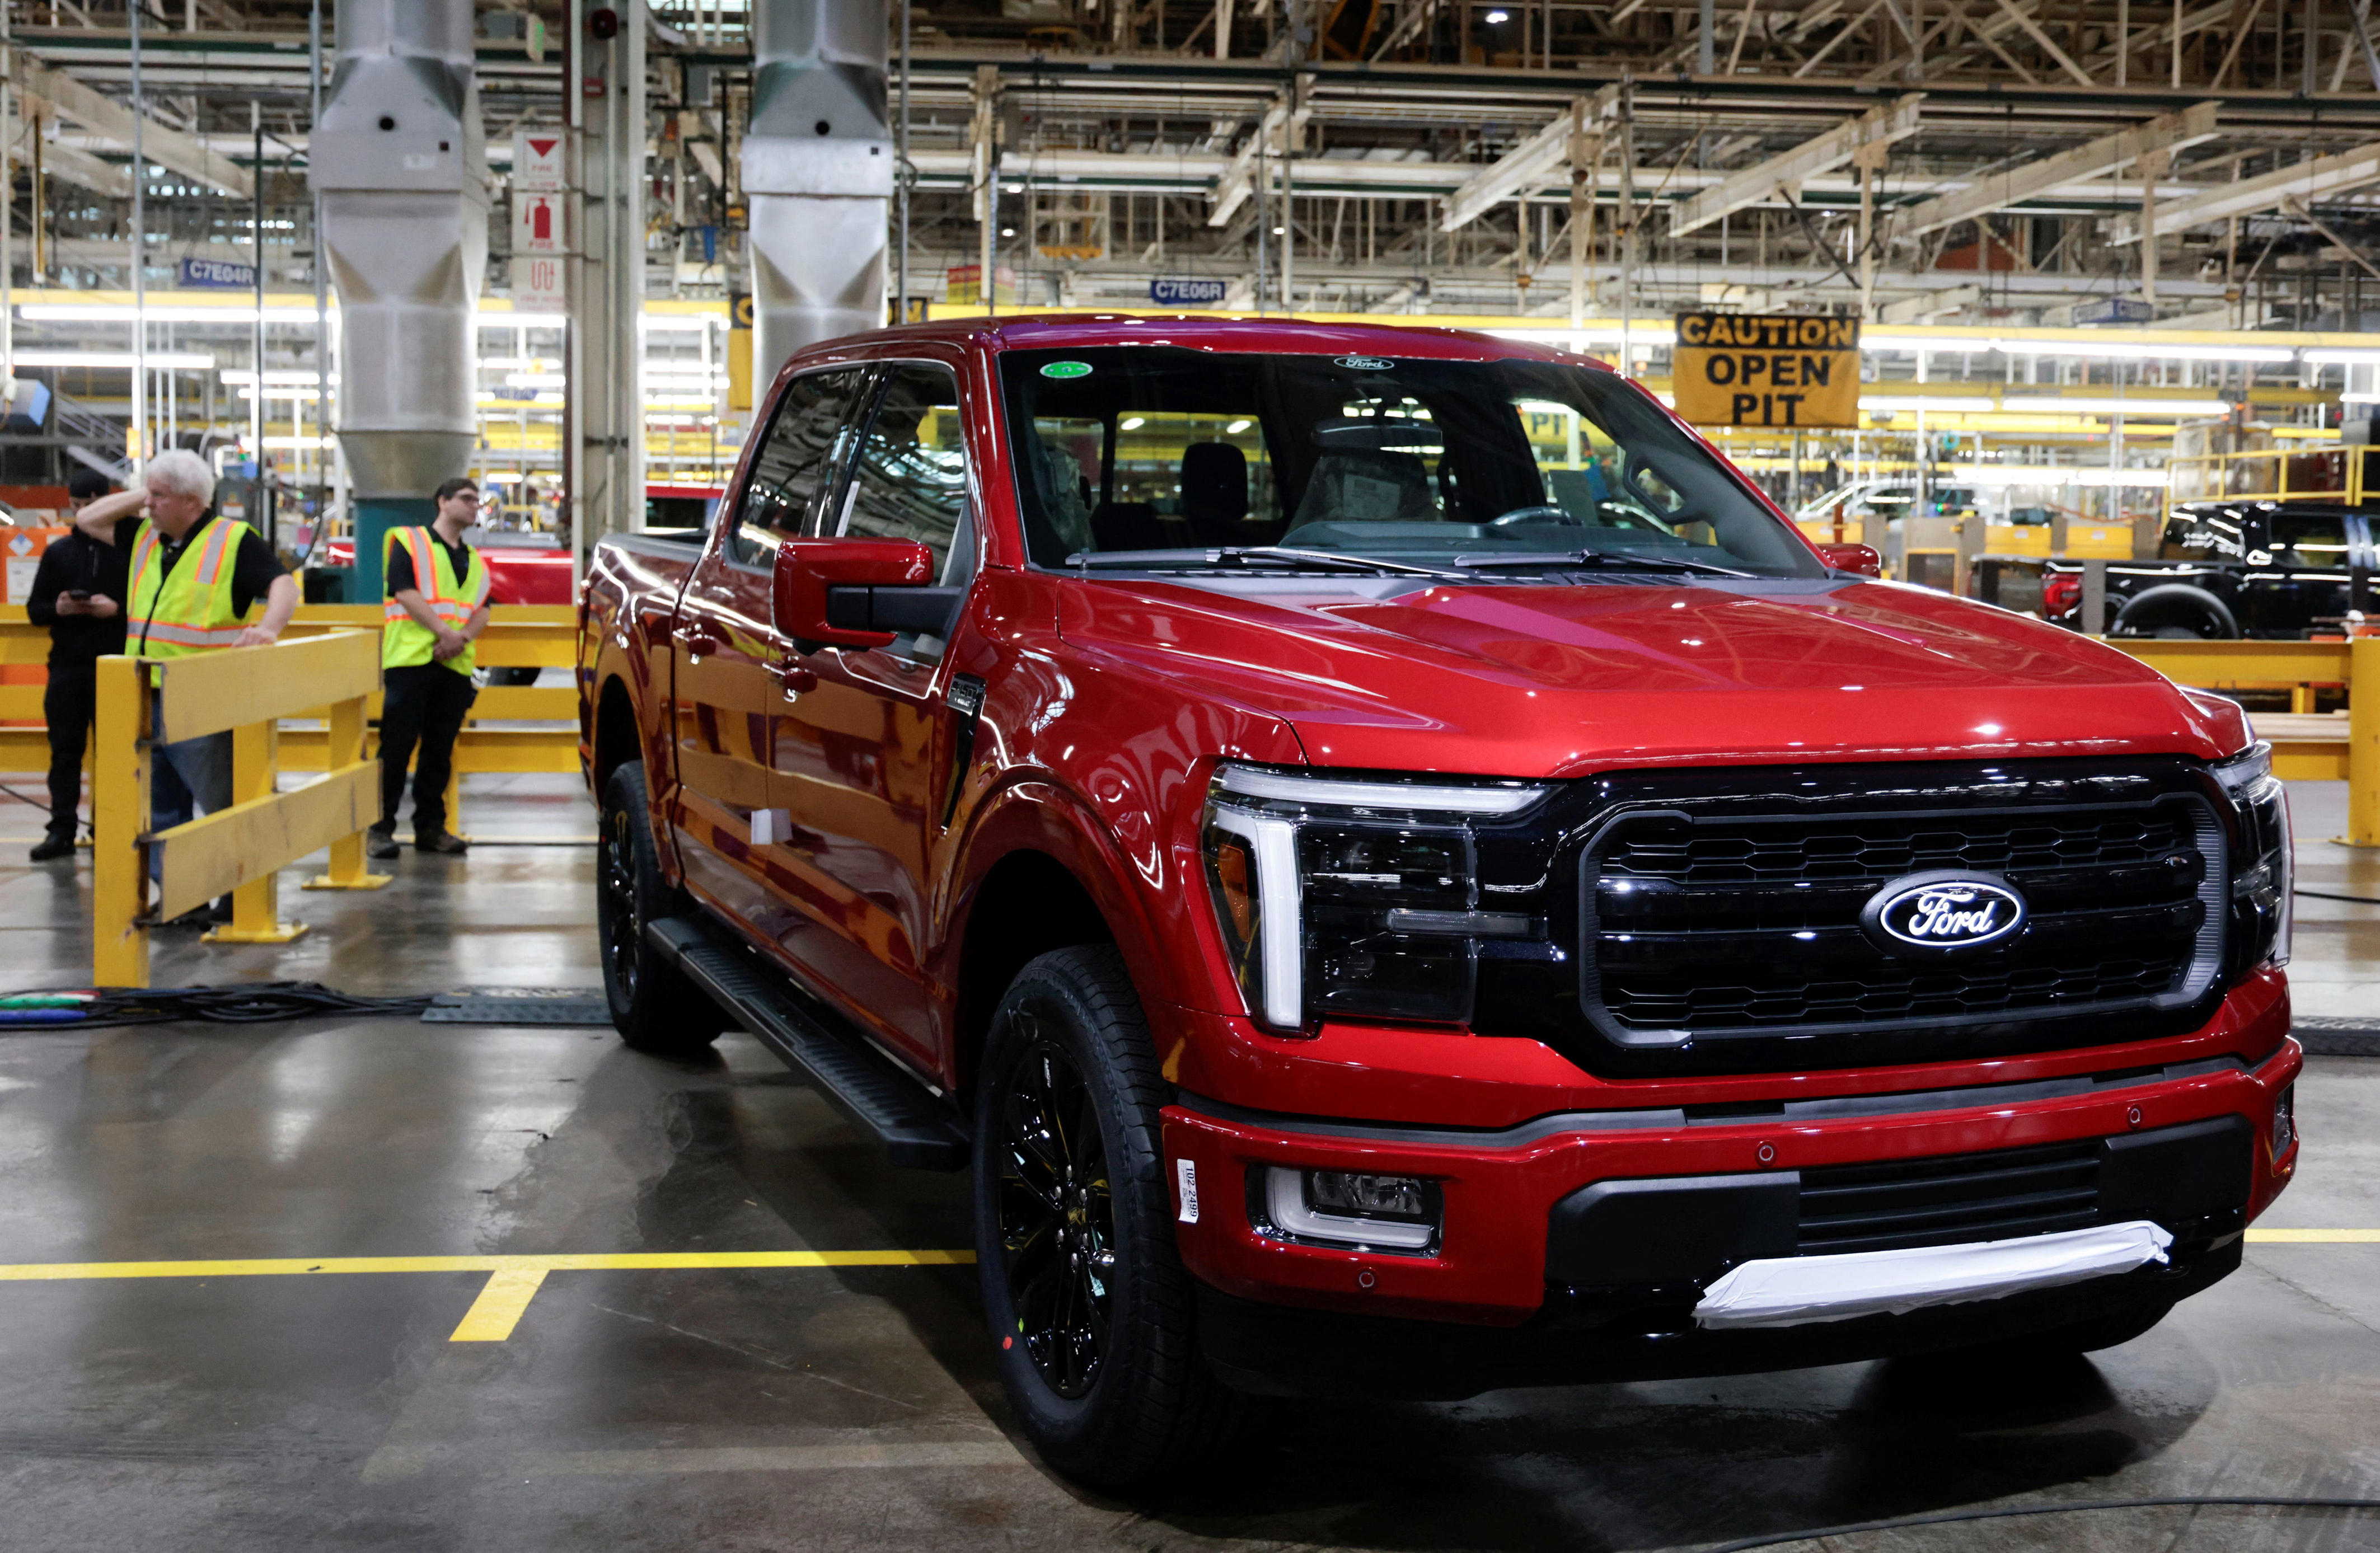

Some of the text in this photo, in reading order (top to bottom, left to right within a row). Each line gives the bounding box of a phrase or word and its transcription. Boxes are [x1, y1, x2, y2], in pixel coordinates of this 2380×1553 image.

[1155, 281, 1222, 299] C7E06R
[1681, 316, 1855, 346] CAUTION
[1346, 358, 1384, 368] Ford
[1706, 354, 1829, 386] OPEN
[1531, 413, 1567, 436] PI
[1732, 394, 1805, 425] PIT
[1909, 892, 1995, 936] Ford
[1186, 1167, 1198, 1217] 102 2499
